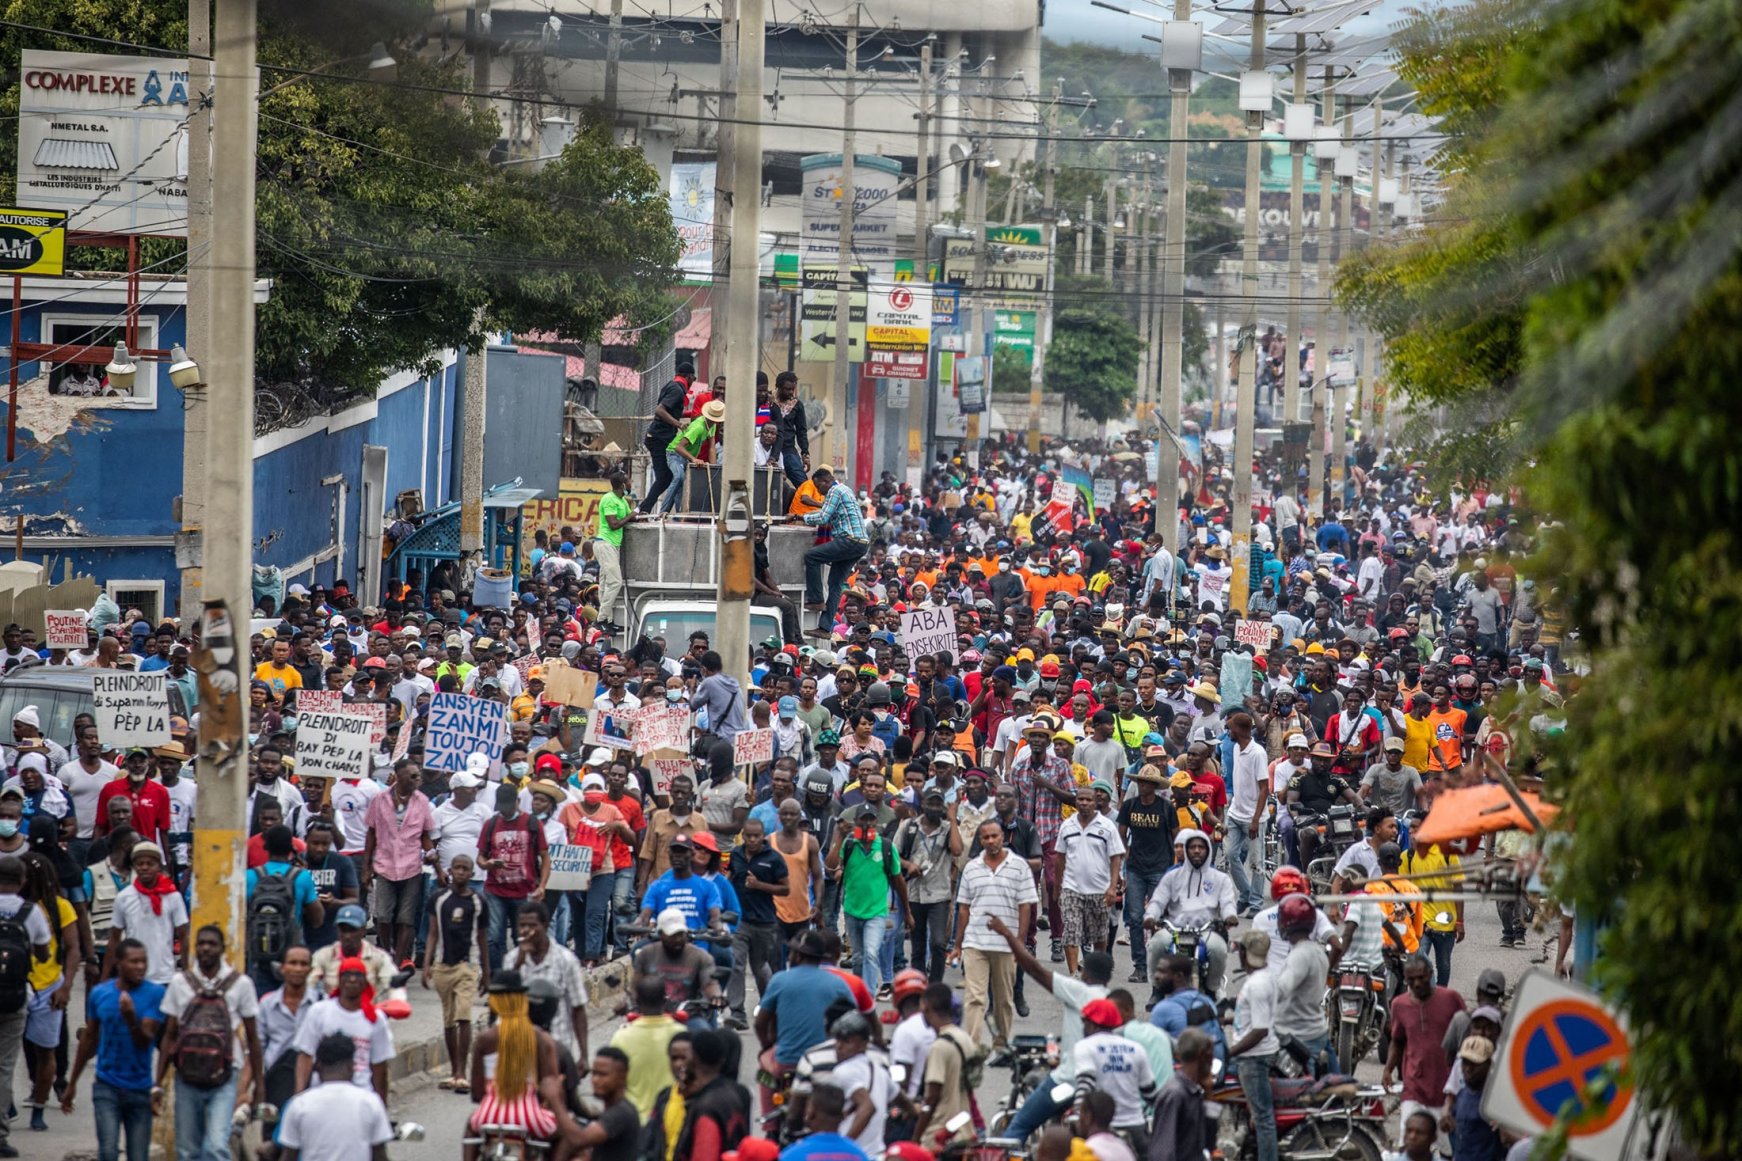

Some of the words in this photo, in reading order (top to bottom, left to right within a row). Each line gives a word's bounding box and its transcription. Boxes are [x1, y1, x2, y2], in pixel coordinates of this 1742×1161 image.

[25, 71, 136, 95] COMPLEXE
[91, 124, 109, 132] S.A.
[873, 327, 909, 335] CAPITAL
[871, 351, 894, 363] ATM
[910, 609, 948, 633] ABA
[431, 692, 503, 718] ANSYEN
[146, 716, 164, 732] LA
[431, 710, 499, 741] ZANMI
[323, 732, 337, 744] DI
[428, 730, 502, 759] TOUJOU
[295, 741, 319, 753] BAY
[322, 745, 345, 757] PEP
[347, 750, 363, 762] LA
[301, 756, 323, 767] YON
[324, 761, 361, 775] CHANS
[1130, 812, 1160, 823] BEAU
